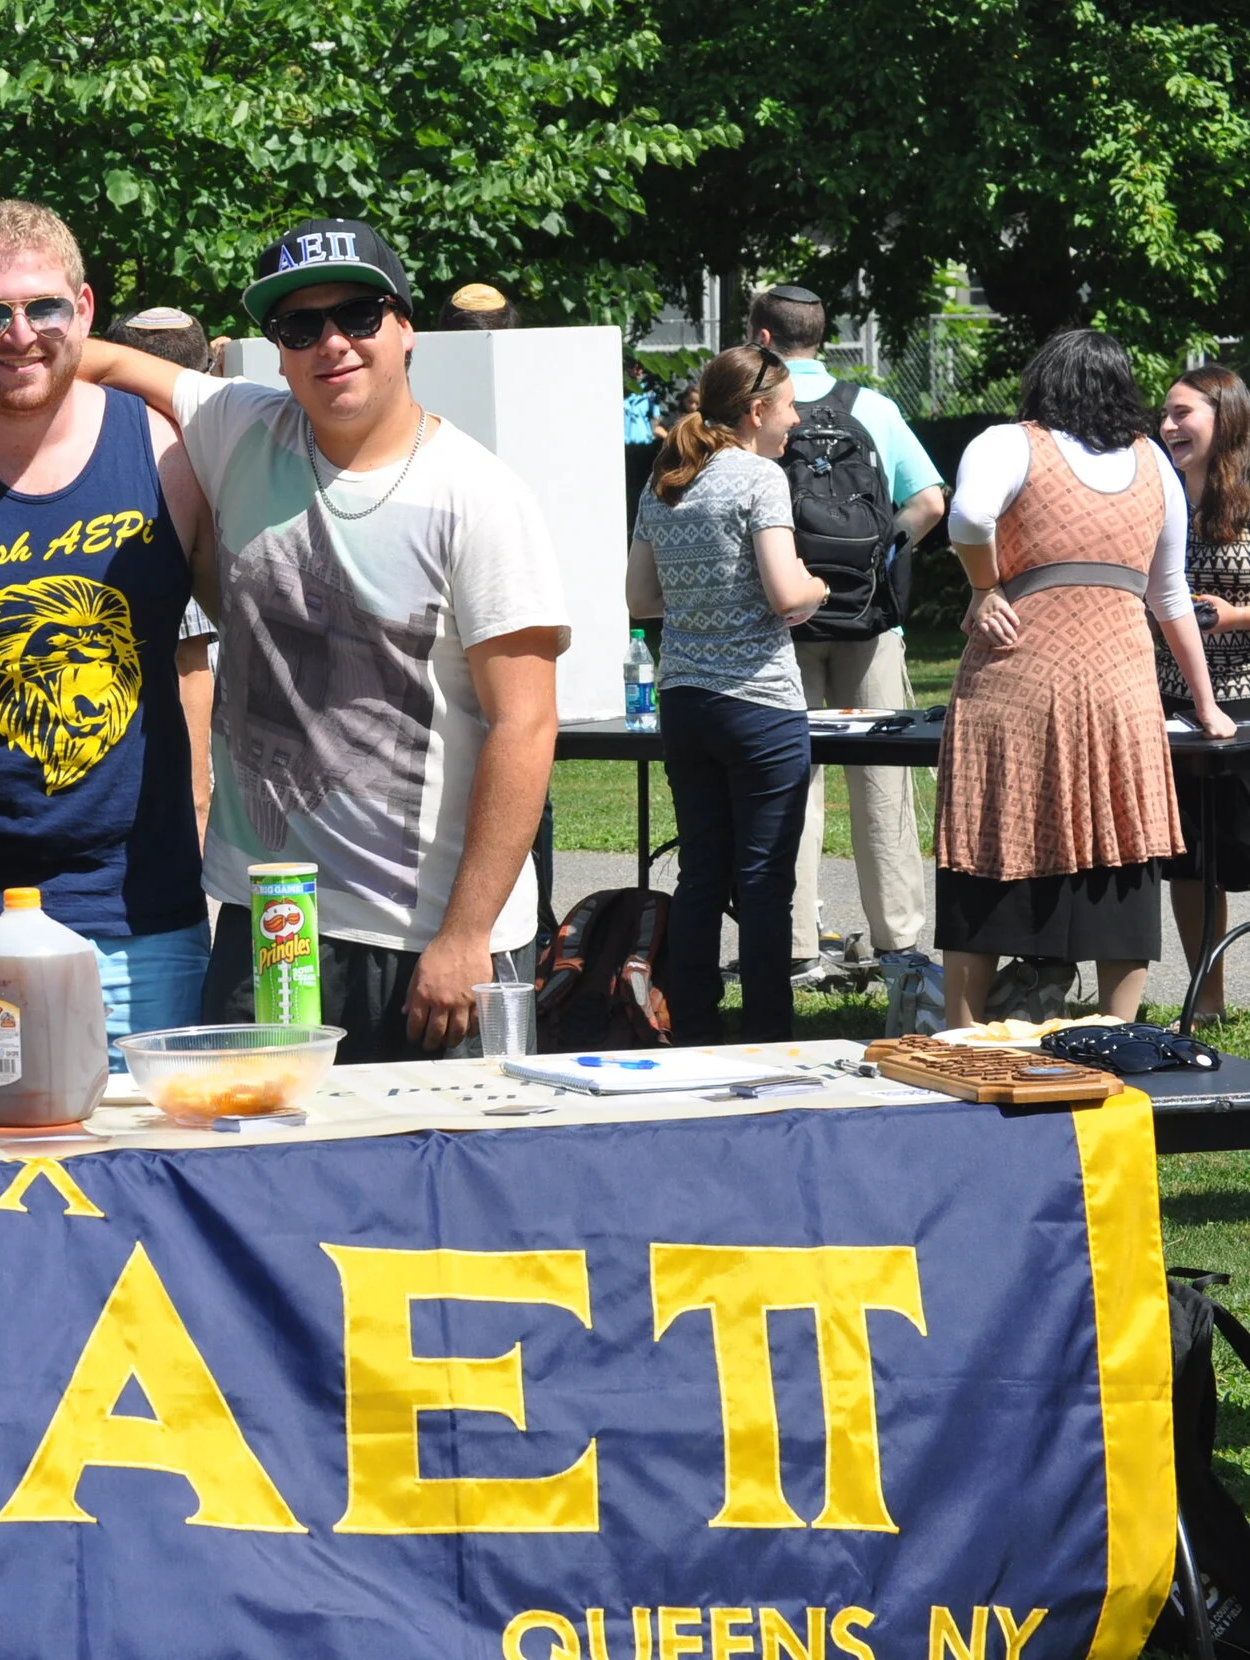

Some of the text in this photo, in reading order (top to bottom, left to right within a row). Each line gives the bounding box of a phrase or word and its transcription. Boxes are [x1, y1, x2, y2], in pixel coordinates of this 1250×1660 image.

[259, 934, 311, 975] Pringles
[502, 1606, 1049, 1660] QUEENS NY
